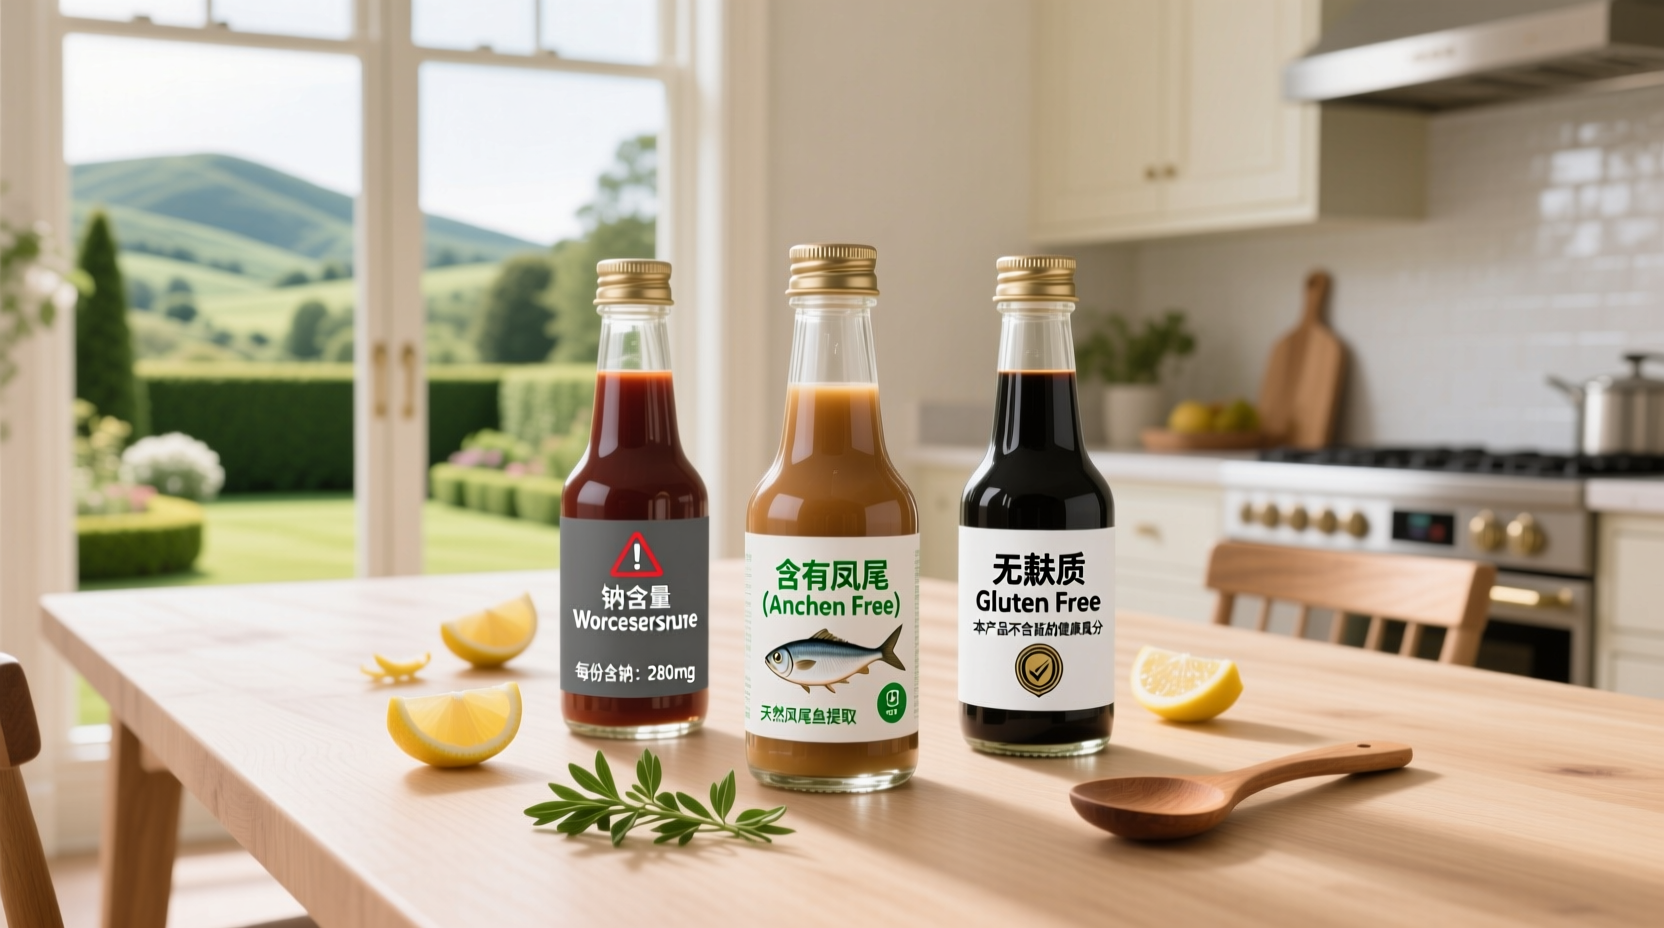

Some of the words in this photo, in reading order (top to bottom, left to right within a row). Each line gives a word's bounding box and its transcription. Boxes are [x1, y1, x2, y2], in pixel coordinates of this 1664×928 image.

[992, 551, 1086, 586] 无麸质
[601, 583, 671, 610] 钠含量
[762, 590, 846, 618] (Anchen
[852, 591, 900, 618] Free)
[976, 590, 1049, 613] Gluten
[1056, 591, 1101, 613] Free
